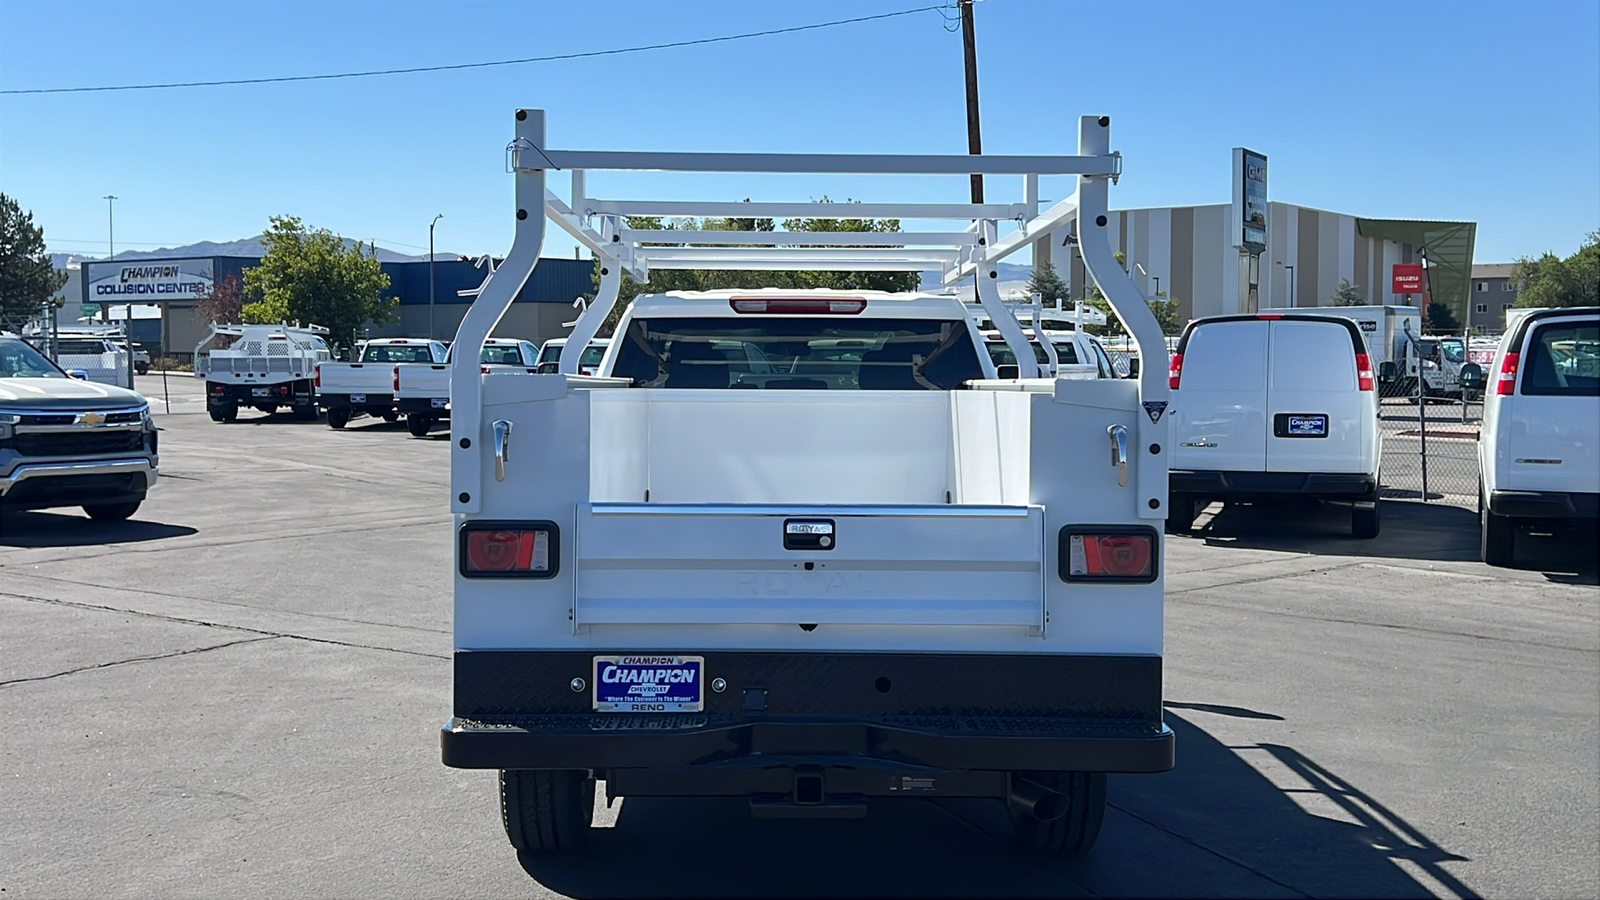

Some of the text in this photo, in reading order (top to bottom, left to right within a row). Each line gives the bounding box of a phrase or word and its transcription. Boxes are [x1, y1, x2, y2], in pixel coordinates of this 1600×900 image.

[120, 265, 179, 283] CHAMPION
[97, 282, 206, 295] COLLISION CENTER
[791, 525, 828, 533] ROYAL
[734, 572, 877, 596] ROYAL
[623, 657, 674, 665] CHAMPION
[602, 665, 696, 684] CHAMPION
[631, 703, 666, 711] RENO
